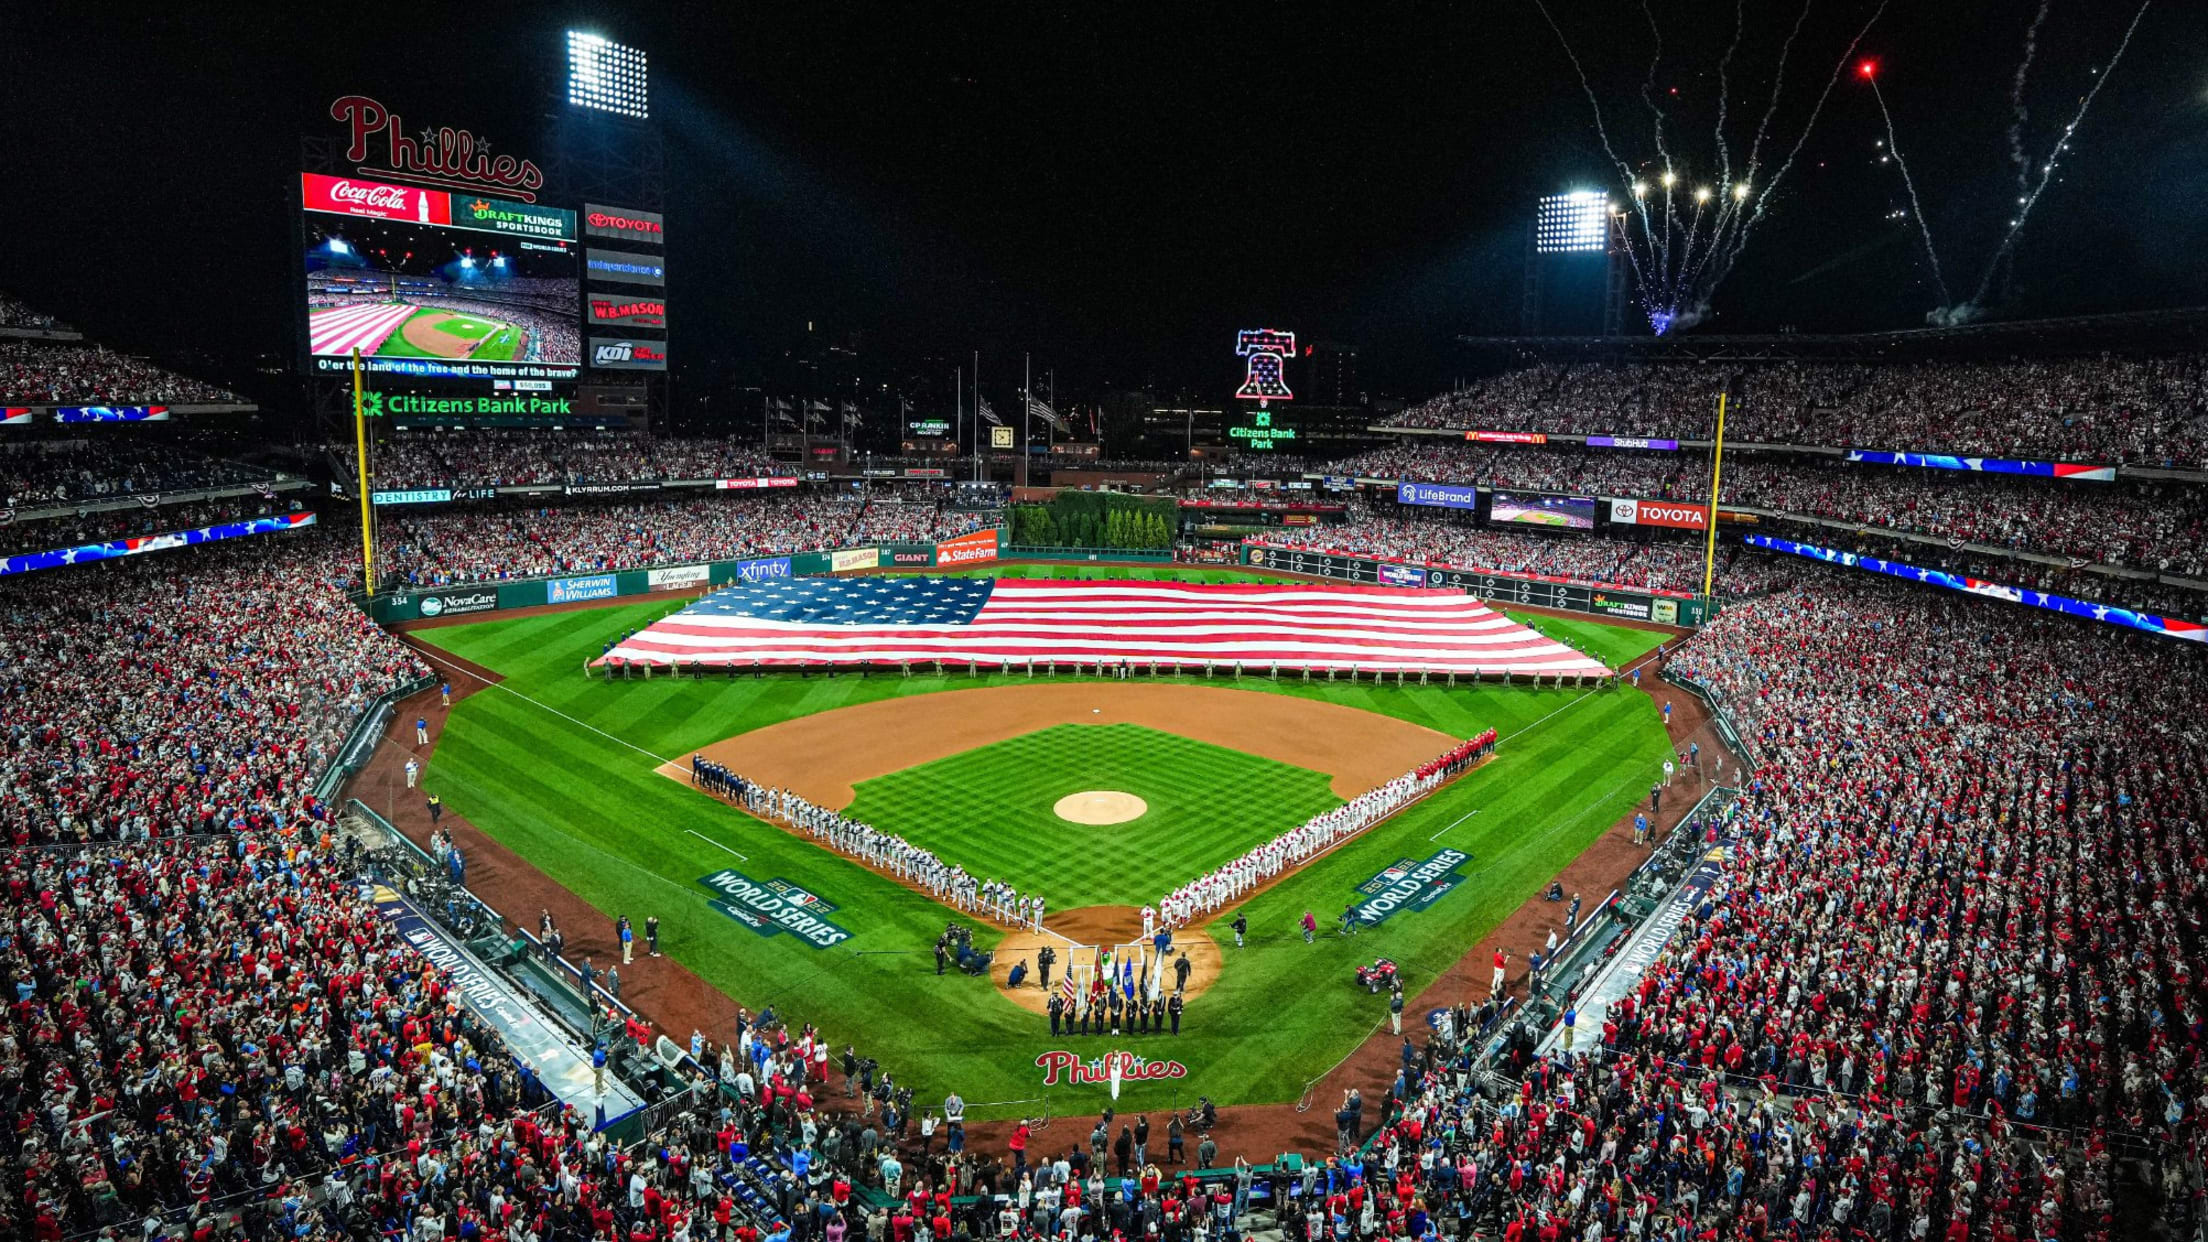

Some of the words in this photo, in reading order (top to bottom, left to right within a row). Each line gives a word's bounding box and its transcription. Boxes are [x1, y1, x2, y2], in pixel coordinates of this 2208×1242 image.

[331, 95, 543, 189] Phillies
[330, 181, 408, 209] Coca-Cola
[474, 209, 562, 227] DRAFTKINGS
[607, 216, 661, 233] TOYOTA
[496, 221, 562, 236] SPORTSBOOK
[318, 359, 345, 370] O'er
[347, 361, 366, 371] te
[368, 361, 392, 371] land
[395, 362, 406, 372] of
[408, 362, 425, 373] the
[428, 363, 448, 373] free
[451, 365, 469, 374] and
[472, 365, 488, 374] the
[490, 366, 516, 376] home
[519, 366, 529, 376] of
[530, 367, 545, 376] the
[547, 367, 577, 377] brave?
[388, 395, 474, 413] Citizens
[478, 397, 527, 413] Bank
[530, 398, 571, 414] Park
[1229, 427, 1269, 438] Citizens
[1271, 428, 1295, 439] Bank
[1251, 440, 1273, 449] Park
[1614, 438, 1648, 449] StubHub
[729, 480, 757, 488] TOYOTA
[769, 478, 796, 486] TOYOTA
[374, 491, 449, 503] DENTISTRY
[452, 490, 467, 500] for
[469, 489, 495, 499] LIFE
[1419, 489, 1471, 503] LifeBrand
[1640, 507, 1703, 523] TOYOTA
[894, 553, 929, 562] GIANT
[741, 562, 788, 580] xfinity
[566, 578, 611, 590] SHERWIN
[443, 594, 496, 608] NovaCare
[1595, 601, 1648, 613] DRAFTKINGS
[767, 880, 789, 893] 20
[1359, 880, 1422, 921] WORLD
[1411, 849, 1466, 883] SERIES
[709, 871, 783, 911] WORLD
[770, 907, 848, 946] SERIES
[1627, 928, 1670, 963] WORLD
[1657, 900, 1692, 929] SERIES
[418, 938, 470, 978] WORLD
[453, 973, 508, 1009] SERIES
[1035, 1051, 1187, 1085] Phillies
